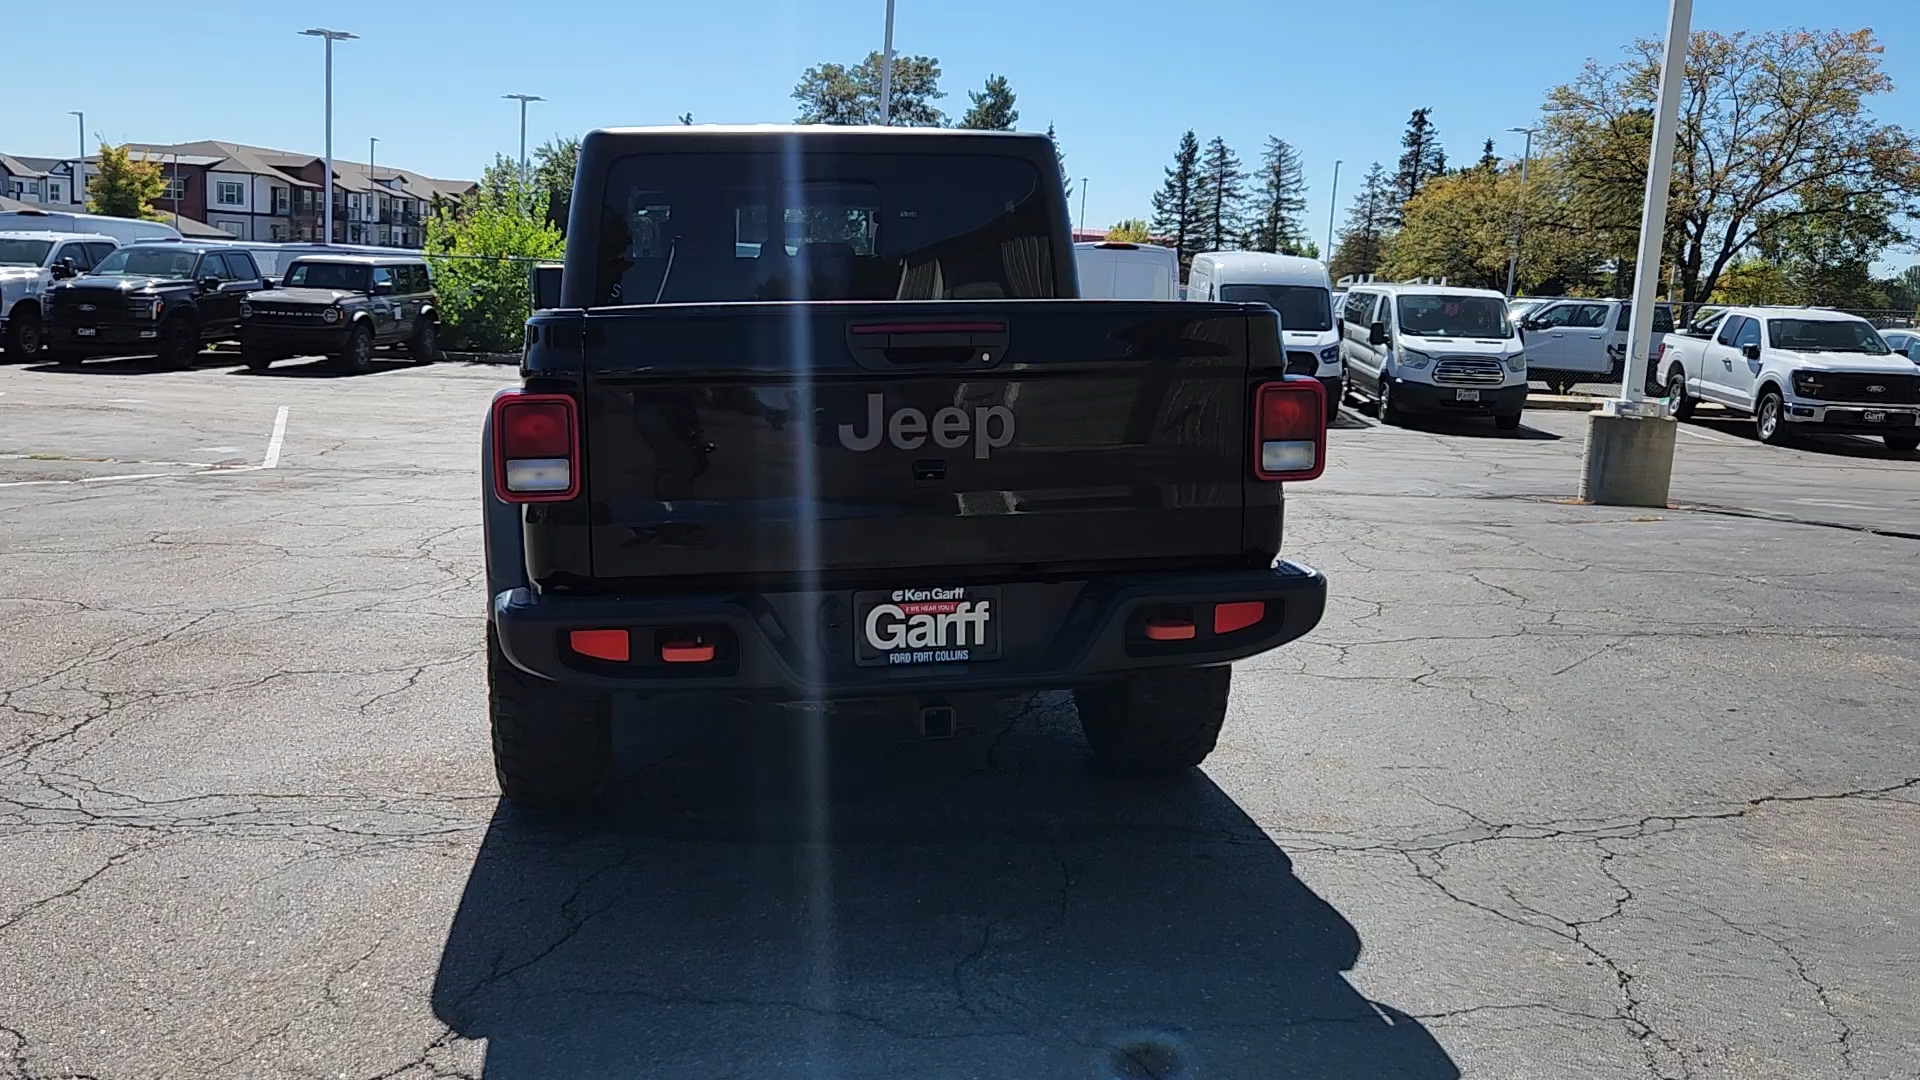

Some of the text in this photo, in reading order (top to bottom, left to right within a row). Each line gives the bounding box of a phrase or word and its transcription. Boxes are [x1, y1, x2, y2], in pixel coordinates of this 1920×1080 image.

[838, 393, 1015, 460] Jeep
[905, 587, 965, 601] Ken Garff
[865, 601, 990, 650] Garff
[889, 649, 969, 664] FORD FORT COLLINS
